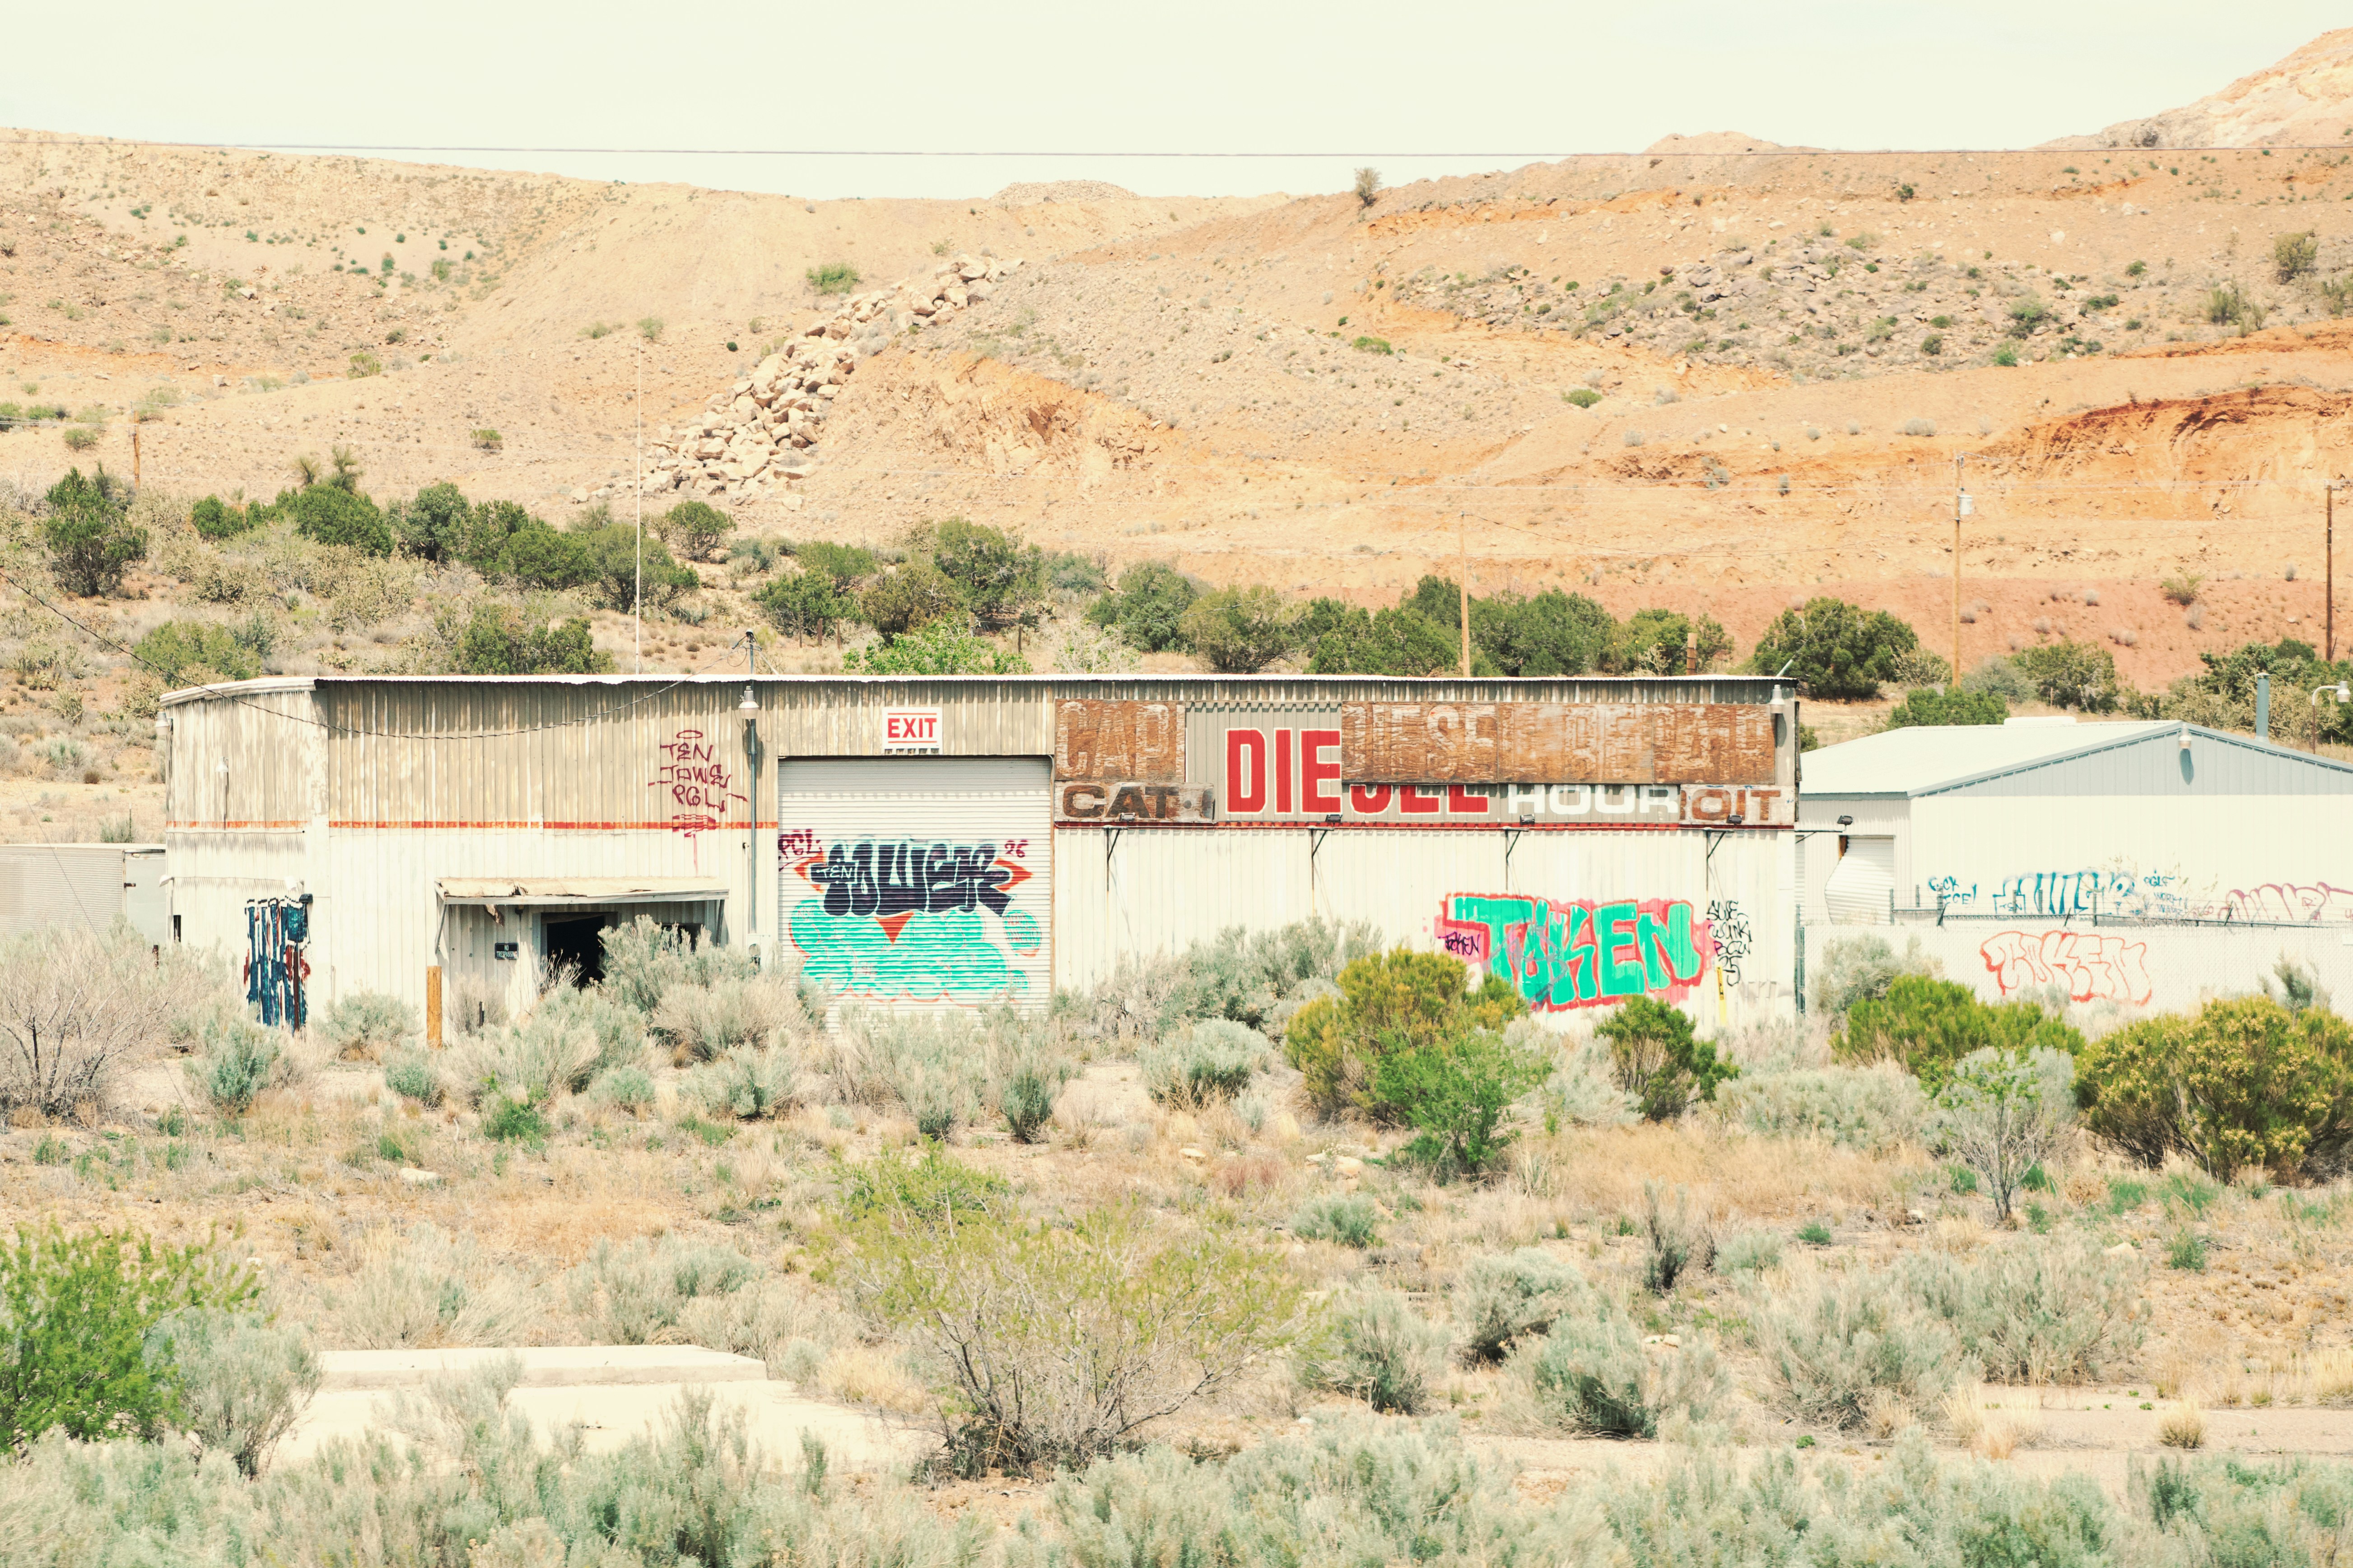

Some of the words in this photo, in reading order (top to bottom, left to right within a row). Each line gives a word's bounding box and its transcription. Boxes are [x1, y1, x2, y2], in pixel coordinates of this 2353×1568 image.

[888, 718, 937, 738] EXIT
[660, 742, 713, 762] TEN
[1063, 785, 1179, 819] CAT
[1508, 784, 1678, 814] HOUR
[1680, 789, 1781, 820] OIT
[815, 865, 853, 879] TEN
[1927, 876, 1960, 892] FCK
